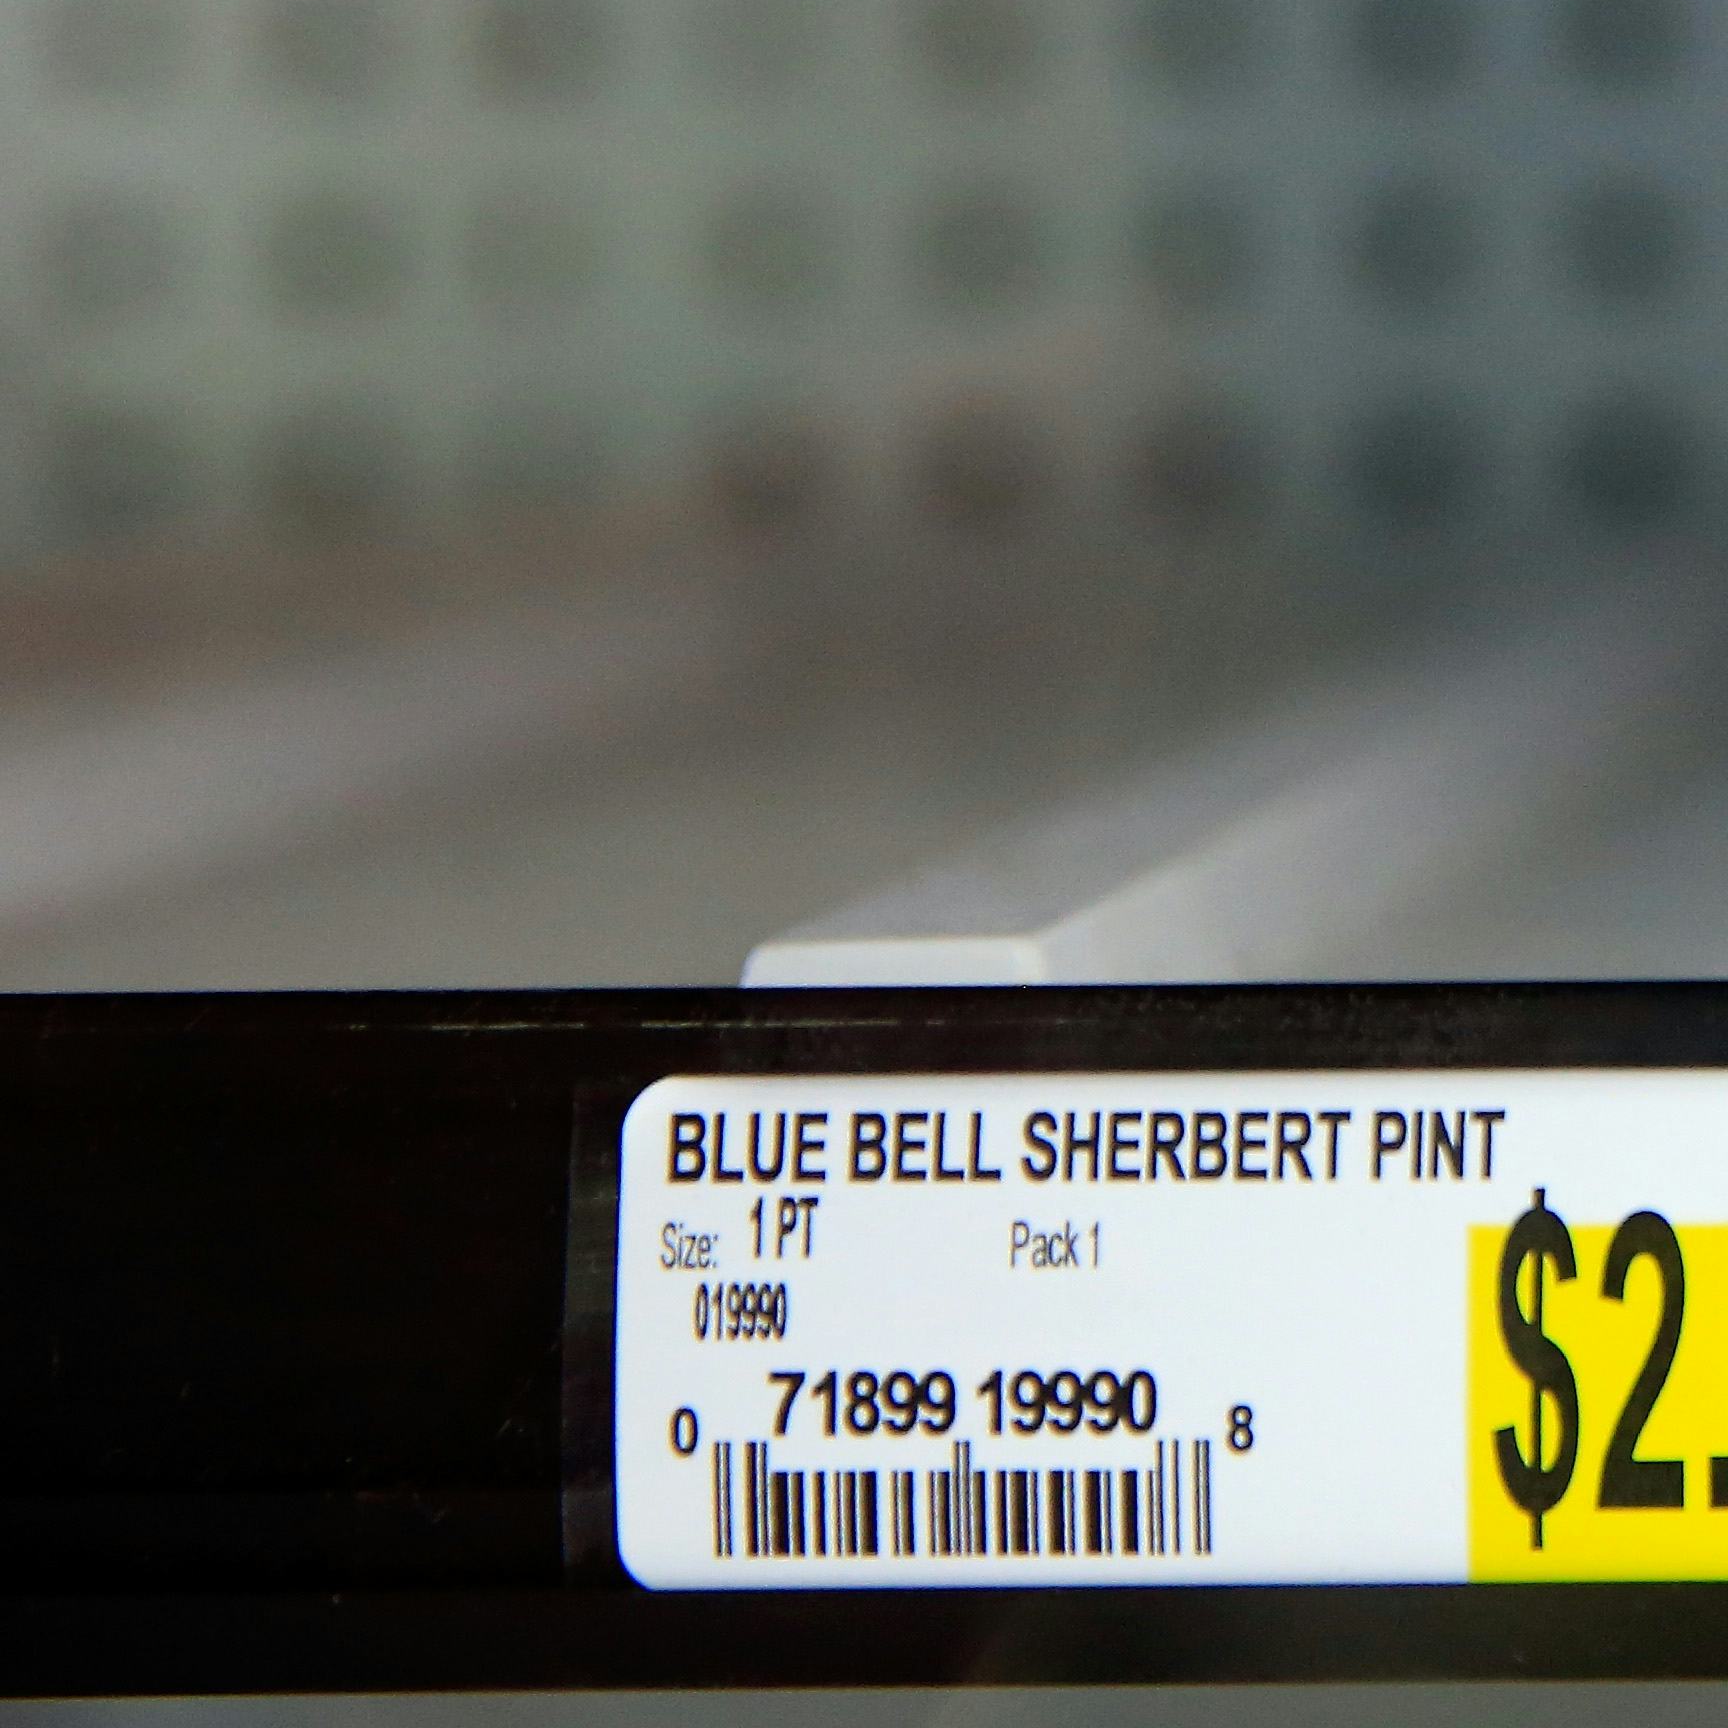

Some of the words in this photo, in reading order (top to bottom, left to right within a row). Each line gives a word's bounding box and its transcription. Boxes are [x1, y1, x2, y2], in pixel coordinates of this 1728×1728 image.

[668, 1111, 829, 1183] BLUE
[849, 1111, 1001, 1183] BELL
[1021, 1110, 1352, 1182] SHERBERT
[1371, 1109, 1506, 1180] PINT
[660, 1221, 719, 1270] Size:
[750, 1196, 764, 1258] 1
[776, 1195, 820, 1259] PT
[1009, 1220, 1079, 1268] Pack
[1090, 1221, 1100, 1267] 1
[693, 1282, 788, 1341] 019990
[669, 1406, 699, 1457] 0
[768, 1369, 957, 1437] 71899
[976, 1369, 1158, 1436] 19990
[1227, 1404, 1254, 1453] 8
